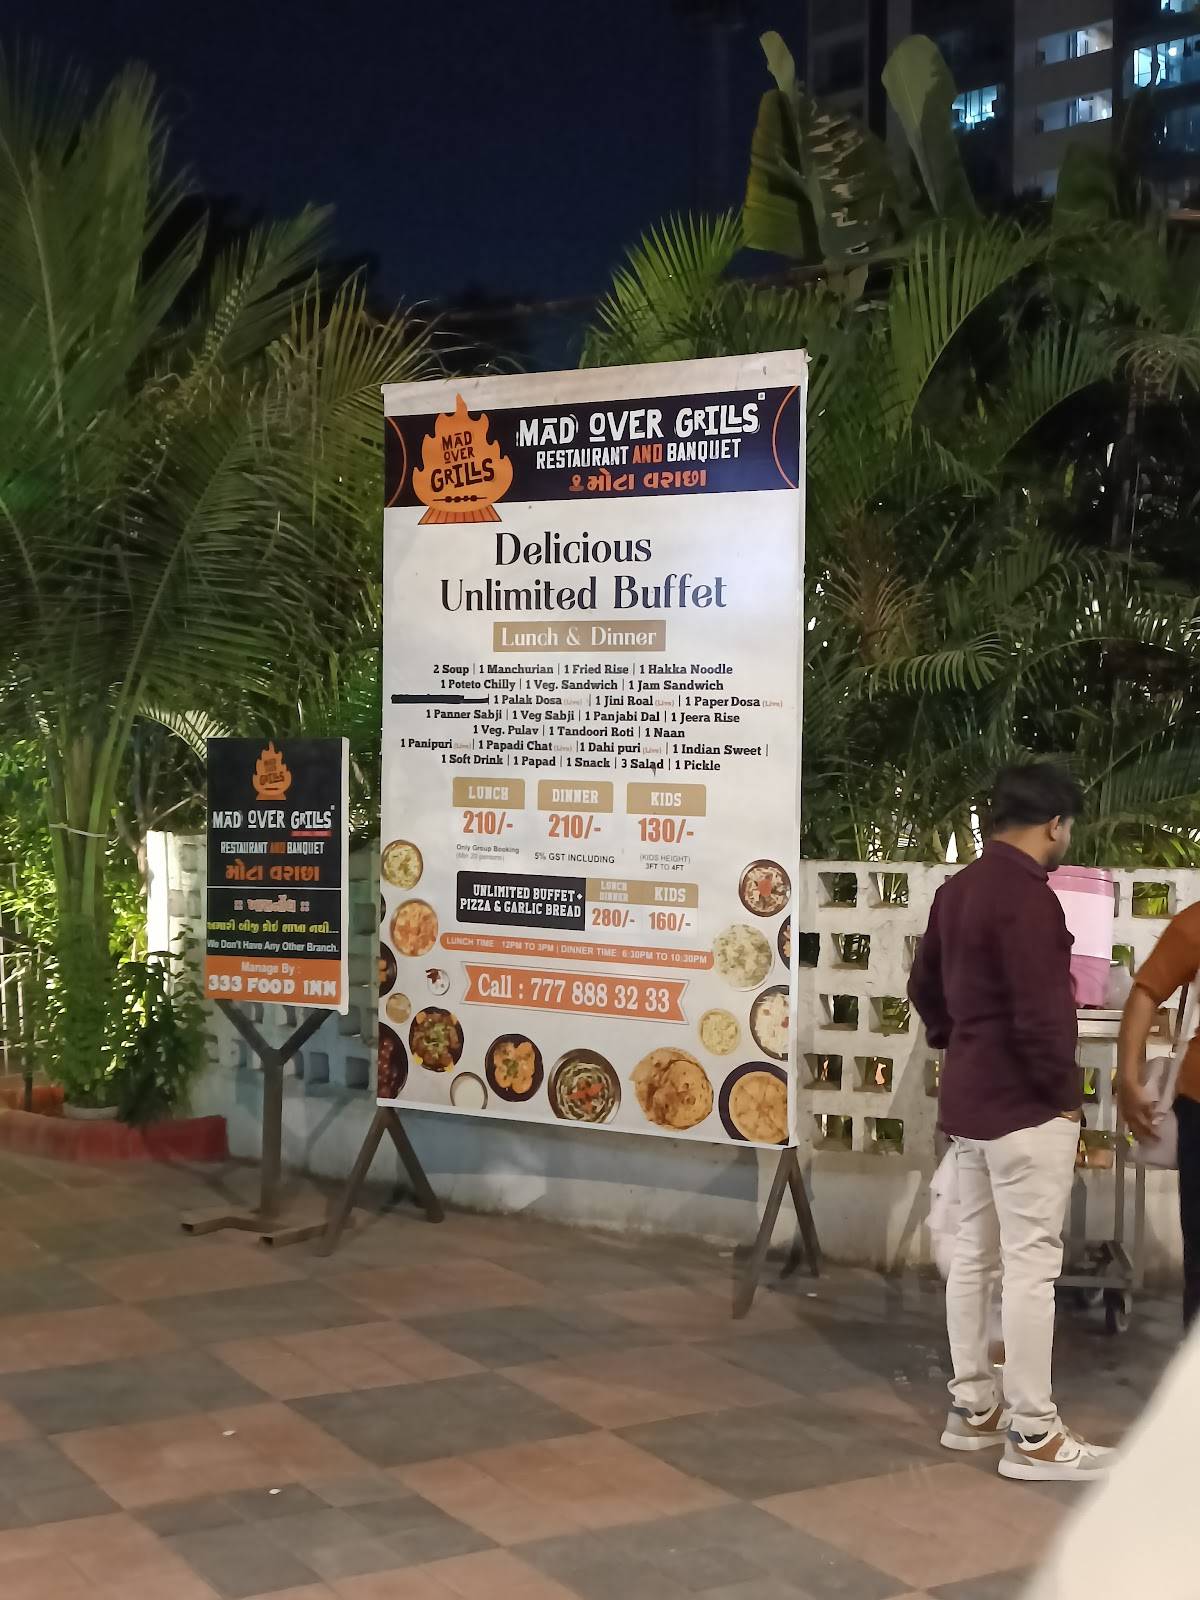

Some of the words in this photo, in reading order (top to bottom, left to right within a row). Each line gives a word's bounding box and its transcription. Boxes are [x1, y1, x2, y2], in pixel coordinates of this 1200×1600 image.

[589, 409, 664, 441] OVER
[673, 402, 760, 437] GRILLS
[443, 446, 475, 464] OVER
[536, 443, 628, 470] RESTAURANT
[632, 442, 663, 464] AND
[667, 438, 741, 462] BANQUET
[430, 457, 495, 493] GRILLS
[495, 532, 652, 565] Delicious
[441, 576, 597, 611] Unlimited
[614, 573, 728, 609] Buffet
[502, 627, 558, 646] Lunch
[566, 628, 580, 645] &
[591, 626, 656, 645] Dinner
[434, 665, 439, 673] 2
[442, 665, 469, 675] Soup
[480, 665, 484, 673] 1
[488, 664, 553, 674] Manchurian
[564, 665, 569, 673] 1
[573, 664, 602, 674] Fried
[605, 665, 628, 674] Rise
[640, 665, 645, 674] 1
[648, 665, 687, 674] Hakka
[691, 664, 733, 674] Noodle
[441, 680, 445, 688] 1
[449, 680, 480, 689] Poteto
[484, 680, 515, 691] Chilly
[526, 680, 531, 689] 1
[534, 680, 558, 692] Veg.
[562, 680, 618, 690] Sandwich
[629, 681, 634, 689] 1
[637, 681, 660, 692] Jam
[664, 680, 723, 691] Sandwich
[494, 695, 499, 704] 1
[502, 695, 532, 704] Palak
[536, 696, 562, 705] Dosa
[596, 696, 600, 705] 1
[604, 696, 624, 707] Jini
[627, 696, 653, 705] Roal
[686, 697, 690, 705] 1
[694, 697, 727, 709] Paper
[731, 697, 760, 707] Dosa
[426, 709, 431, 718] 1
[434, 710, 470, 718] Panner
[474, 710, 501, 721] Sabji
[513, 711, 517, 719] 1
[521, 711, 541, 722] Veg
[545, 711, 574, 722] Sabji
[586, 712, 590, 720] 1
[594, 712, 637, 723] Panjabi
[641, 712, 659, 721] Dal
[671, 713, 676, 721] 1
[680, 713, 710, 724] Jeera
[714, 713, 740, 722] Rise
[474, 725, 478, 734] 1
[482, 726, 504, 736] Veg.
[508, 726, 538, 735] Pulav
[549, 727, 554, 735] 1
[558, 727, 607, 736] Tandoori
[611, 727, 634, 737] Roti
[645, 728, 650, 737] 1
[654, 728, 685, 737] Naan
[401, 739, 405, 747] 1
[408, 739, 452, 750] Panipuri
[479, 741, 483, 749] 1
[487, 740, 523, 752] Papadi
[527, 741, 552, 750] Chat
[580, 743, 585, 751] 1
[589, 743, 614, 752] Dahi
[618, 743, 641, 755] puri
[673, 745, 678, 753] 1
[682, 745, 720, 754] Indian
[724, 745, 761, 755] Sweet
[442, 755, 446, 763] 1
[449, 755, 470, 764] Soft
[474, 755, 503, 764] Drink
[514, 756, 518, 765] 1
[522, 756, 556, 768] Papad
[567, 758, 571, 766] 1
[575, 757, 610, 768] Snack
[622, 759, 627, 768] 3
[631, 759, 664, 769] Salad
[675, 760, 680, 769] 1
[684, 760, 720, 770] Pickle
[468, 786, 509, 800] LUNCH
[552, 789, 599, 804] DINNER
[651, 792, 682, 807] KIDS
[248, 810, 285, 829] OVER
[291, 810, 332, 829] GRILLS
[463, 811, 513, 834] 210/-
[548, 814, 601, 839] 210/-
[638, 818, 694, 843] 130/-
[221, 841, 268, 853] RESTAURANT
[287, 841, 324, 855] BANQUET
[456, 844, 471, 853] Only
[473, 845, 492, 853] Group
[493, 845, 520, 854] Booking
[534, 852, 546, 861] 5%
[548, 853, 566, 862] GST
[568, 853, 615, 864] INCLUDING
[473, 884, 530, 899] UNLIMITED
[533, 888, 575, 902] BUFFET
[600, 881, 627, 891] LUNCH
[654, 887, 686, 902] KIDS
[460, 898, 491, 911] PIZZA
[494, 901, 501, 912] &
[503, 902, 542, 915] GARLIC
[546, 905, 581, 918] BREAD
[592, 908, 635, 927] 280/-
[649, 912, 691, 931] 160/-
[208, 940, 219, 948] We
[221, 940, 241, 949] Don't
[243, 941, 262, 949] Have
[264, 942, 280, 952] Any
[282, 942, 305, 951] Other
[447, 936, 474, 946] LUNCH
[475, 938, 494, 947] TIME
[502, 940, 522, 949] 12PM
[524, 942, 535, 950] TO
[538, 943, 554, 952] 3PM
[561, 945, 593, 955] DINNER
[597, 947, 617, 957] TIME
[622, 950, 653, 960] 630PM
[656, 951, 668, 961] TO
[671, 953, 707, 964] 1030PM
[241, 961, 278, 975] Manage
[281, 963, 295, 975] By
[208, 975, 242, 992] 333
[248, 978, 295, 994] FOOD
[303, 980, 336, 996] INN
[478, 973, 512, 999] Call
[530, 978, 566, 1003] 777
[572, 982, 608, 1007] 888
[614, 985, 638, 1010] 32
[645, 988, 669, 1013] 33
